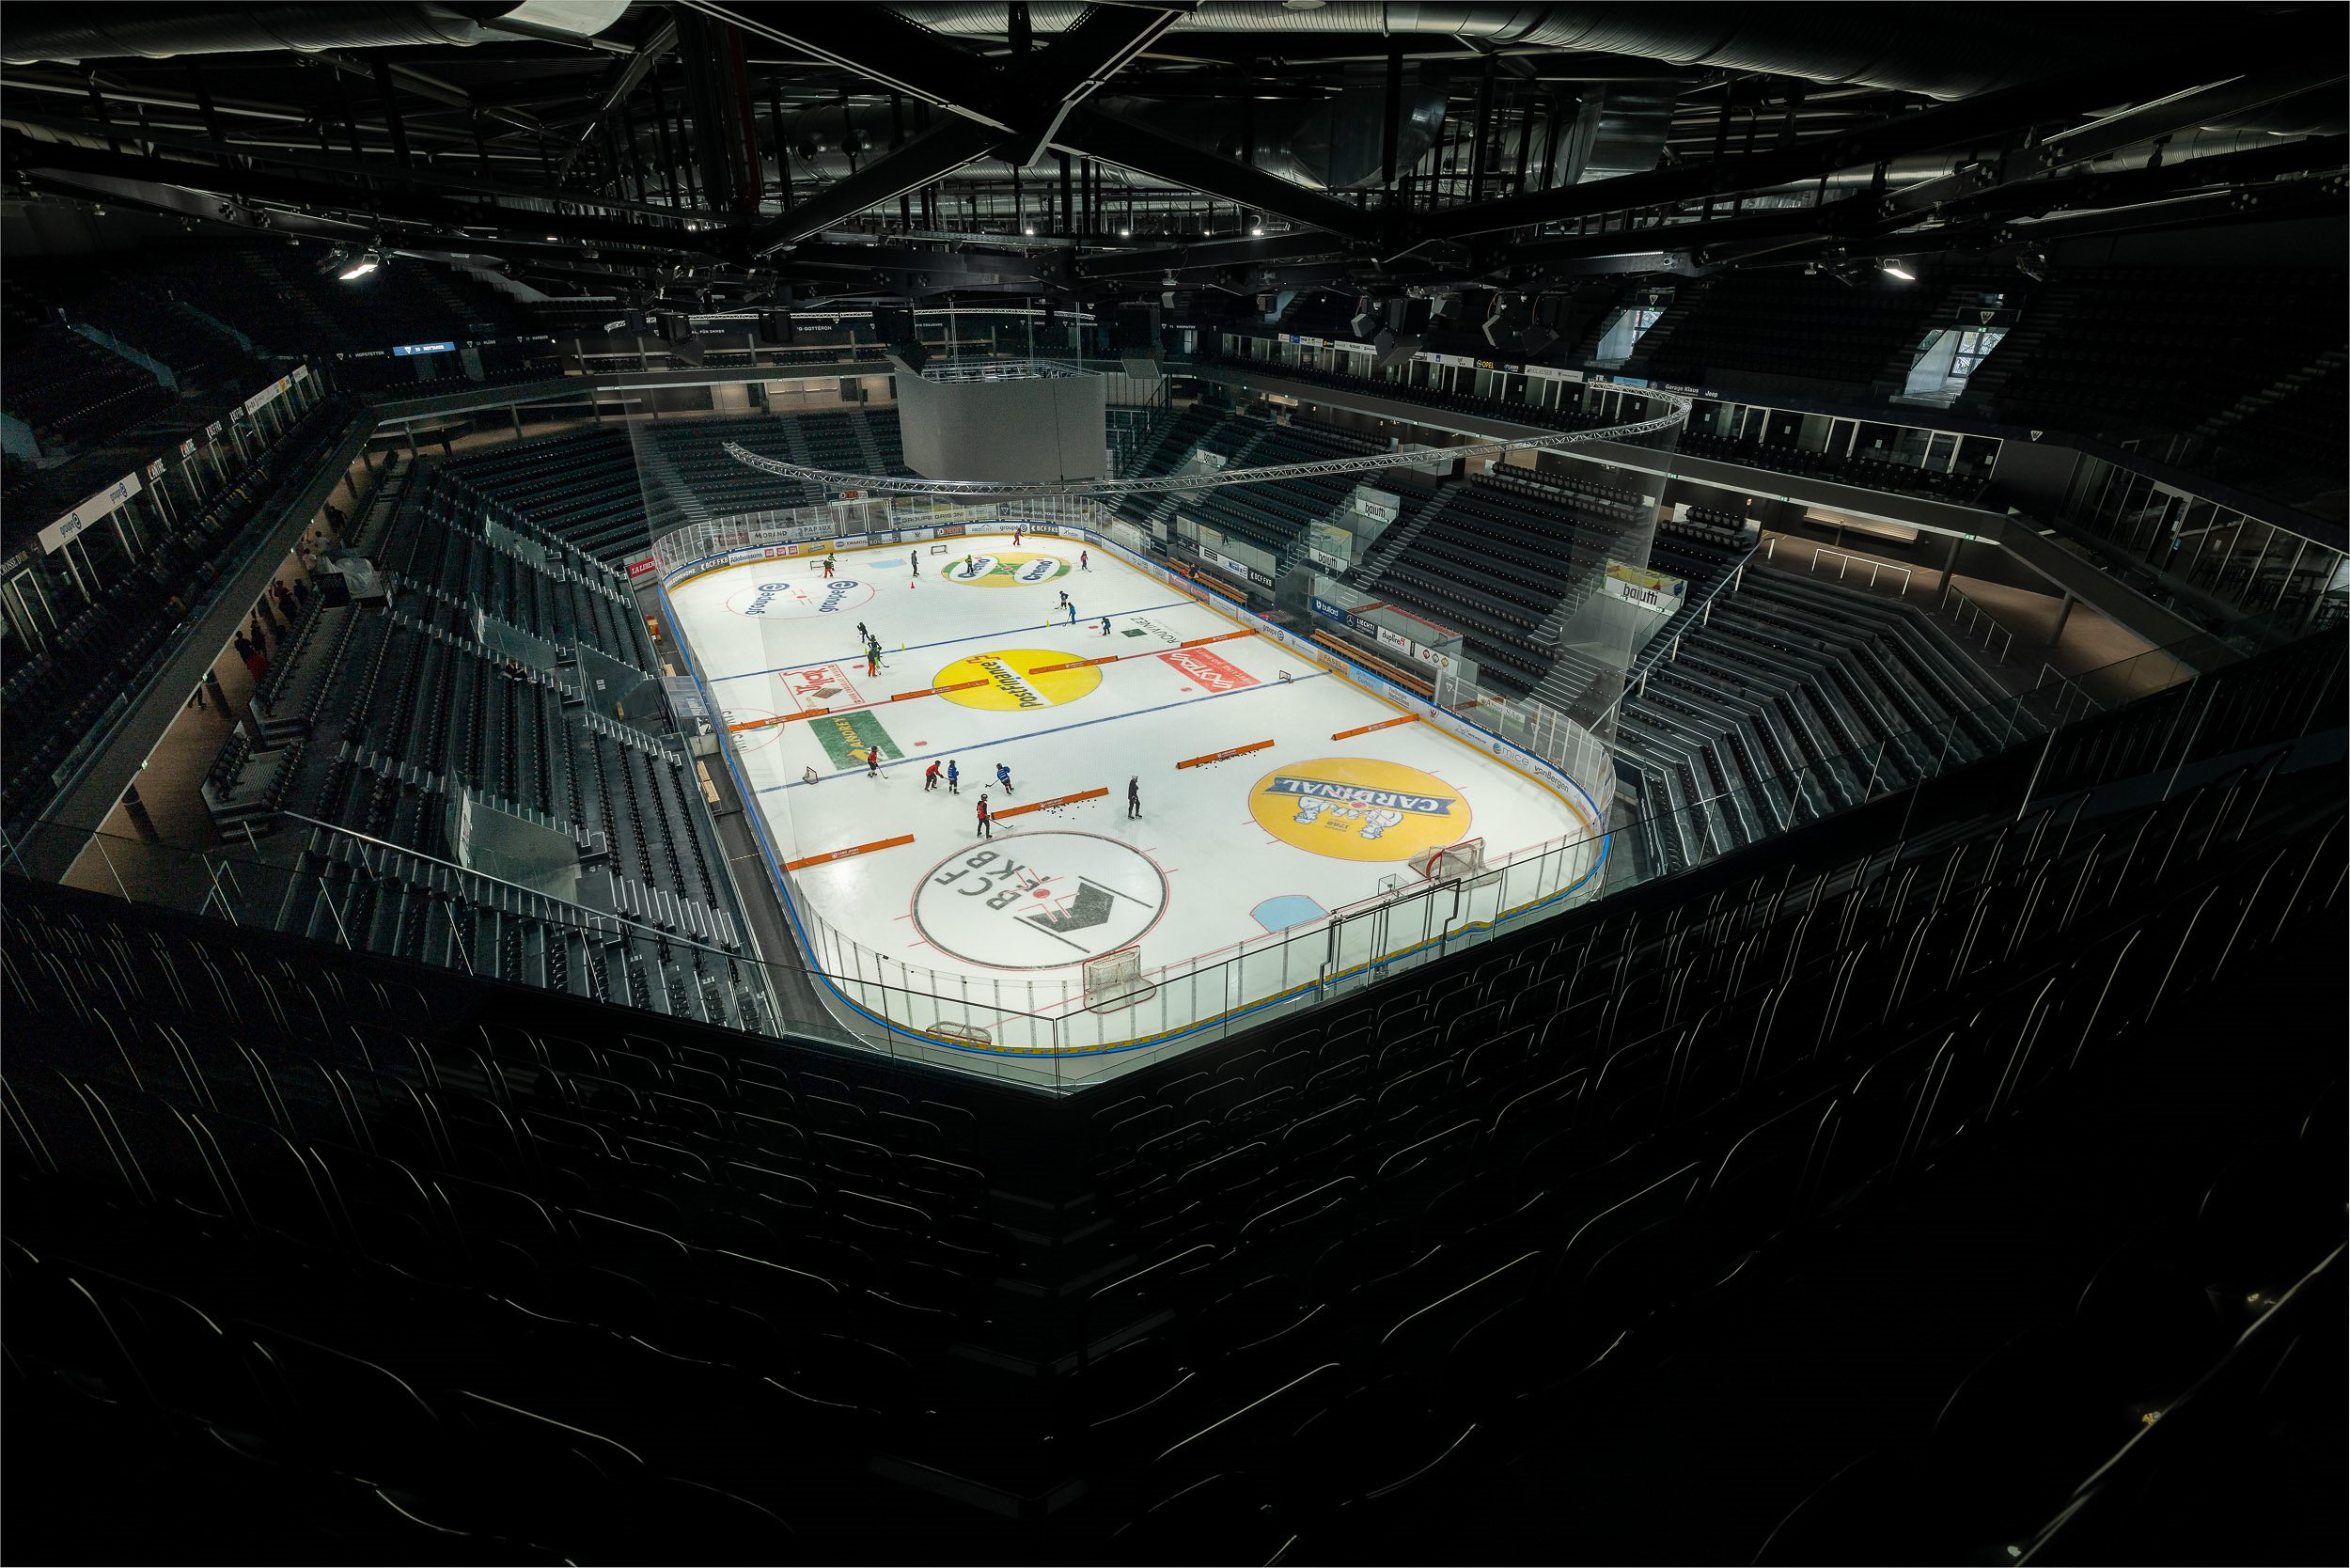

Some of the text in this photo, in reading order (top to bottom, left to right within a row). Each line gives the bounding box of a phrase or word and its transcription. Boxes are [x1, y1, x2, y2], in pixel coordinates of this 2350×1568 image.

[1481, 360, 1496, 370] OPEL
[1666, 384, 1683, 392] Garage
[1023, 560, 1053, 581] Cremo
[980, 659, 1044, 710] PostFinance
[833, 717, 865, 748] ANDREY
[1282, 778, 1439, 812] CARDINAL
